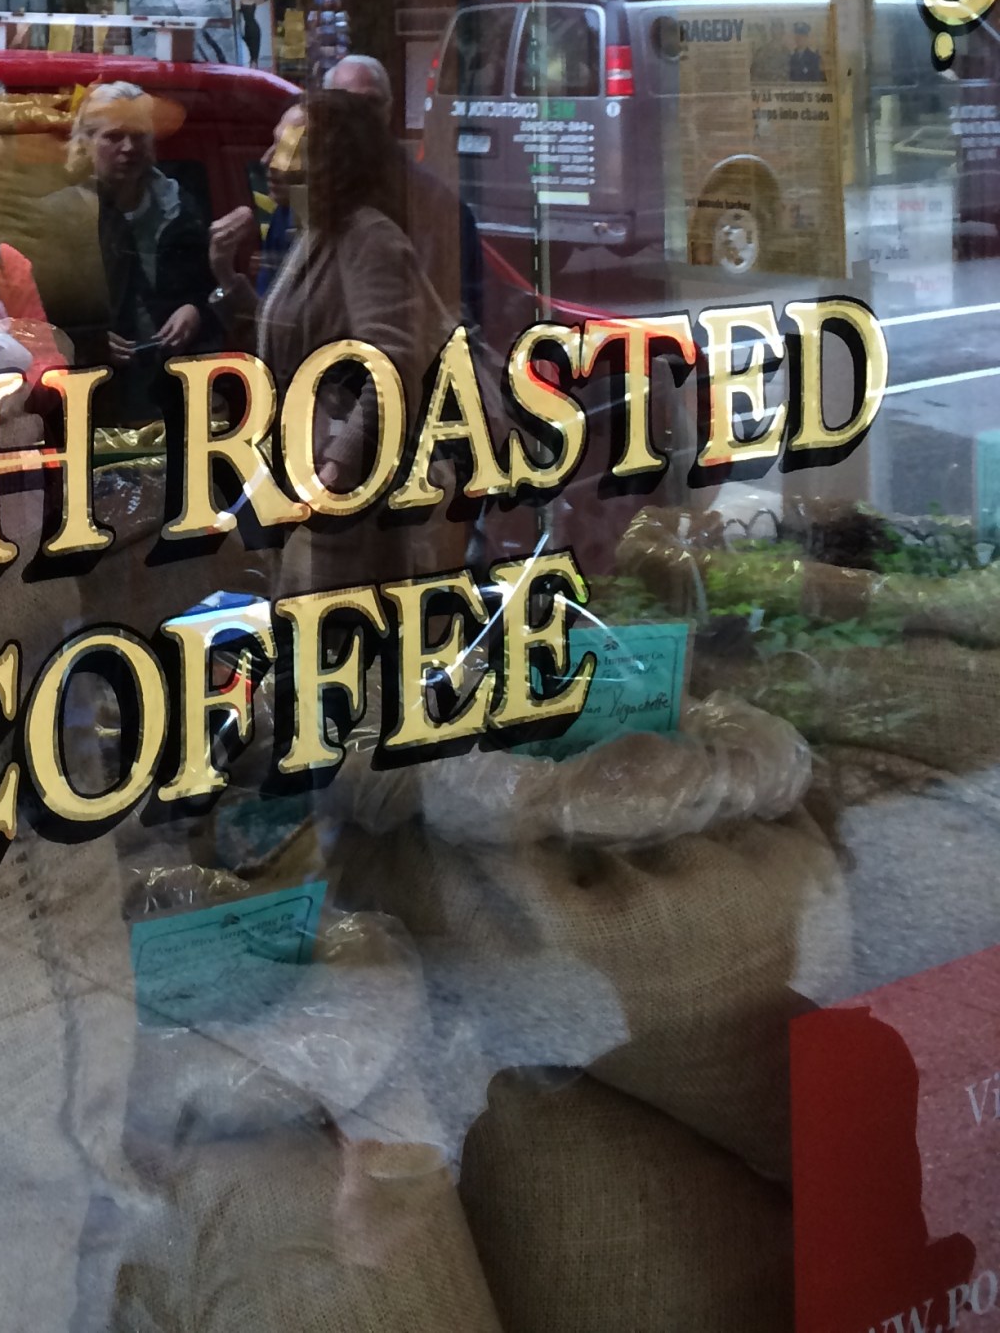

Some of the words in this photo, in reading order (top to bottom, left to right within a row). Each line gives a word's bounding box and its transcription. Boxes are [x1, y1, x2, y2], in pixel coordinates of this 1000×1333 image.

[775, 90, 812, 102] victim's
[815, 92, 833, 103] son
[780, 107, 798, 120] into
[162, 297, 889, 541] ROASTED
